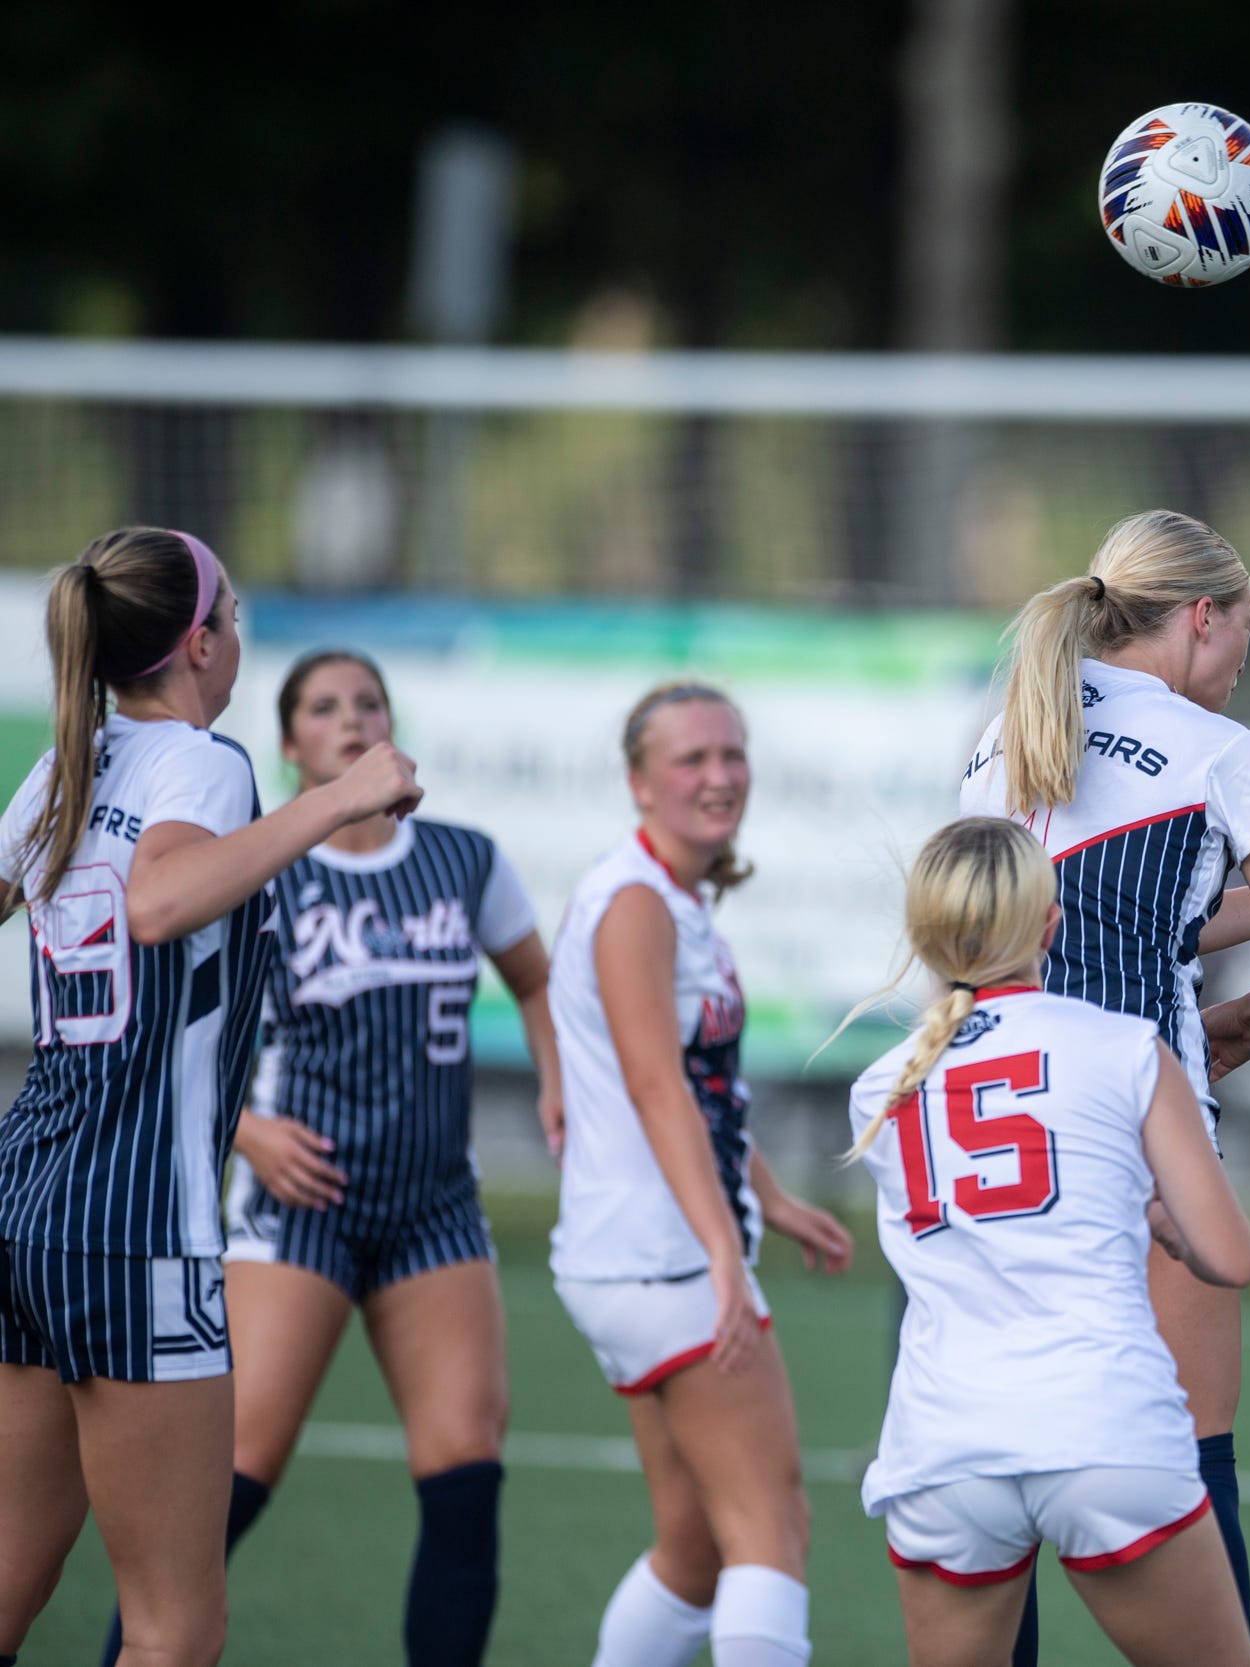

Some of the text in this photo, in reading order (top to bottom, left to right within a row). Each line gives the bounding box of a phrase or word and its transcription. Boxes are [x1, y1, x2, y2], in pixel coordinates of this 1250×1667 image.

[1083, 729, 1169, 777] ARS
[89, 805, 142, 844] ARS
[426, 983, 472, 1064] 5
[886, 1049, 1060, 1241] 15
